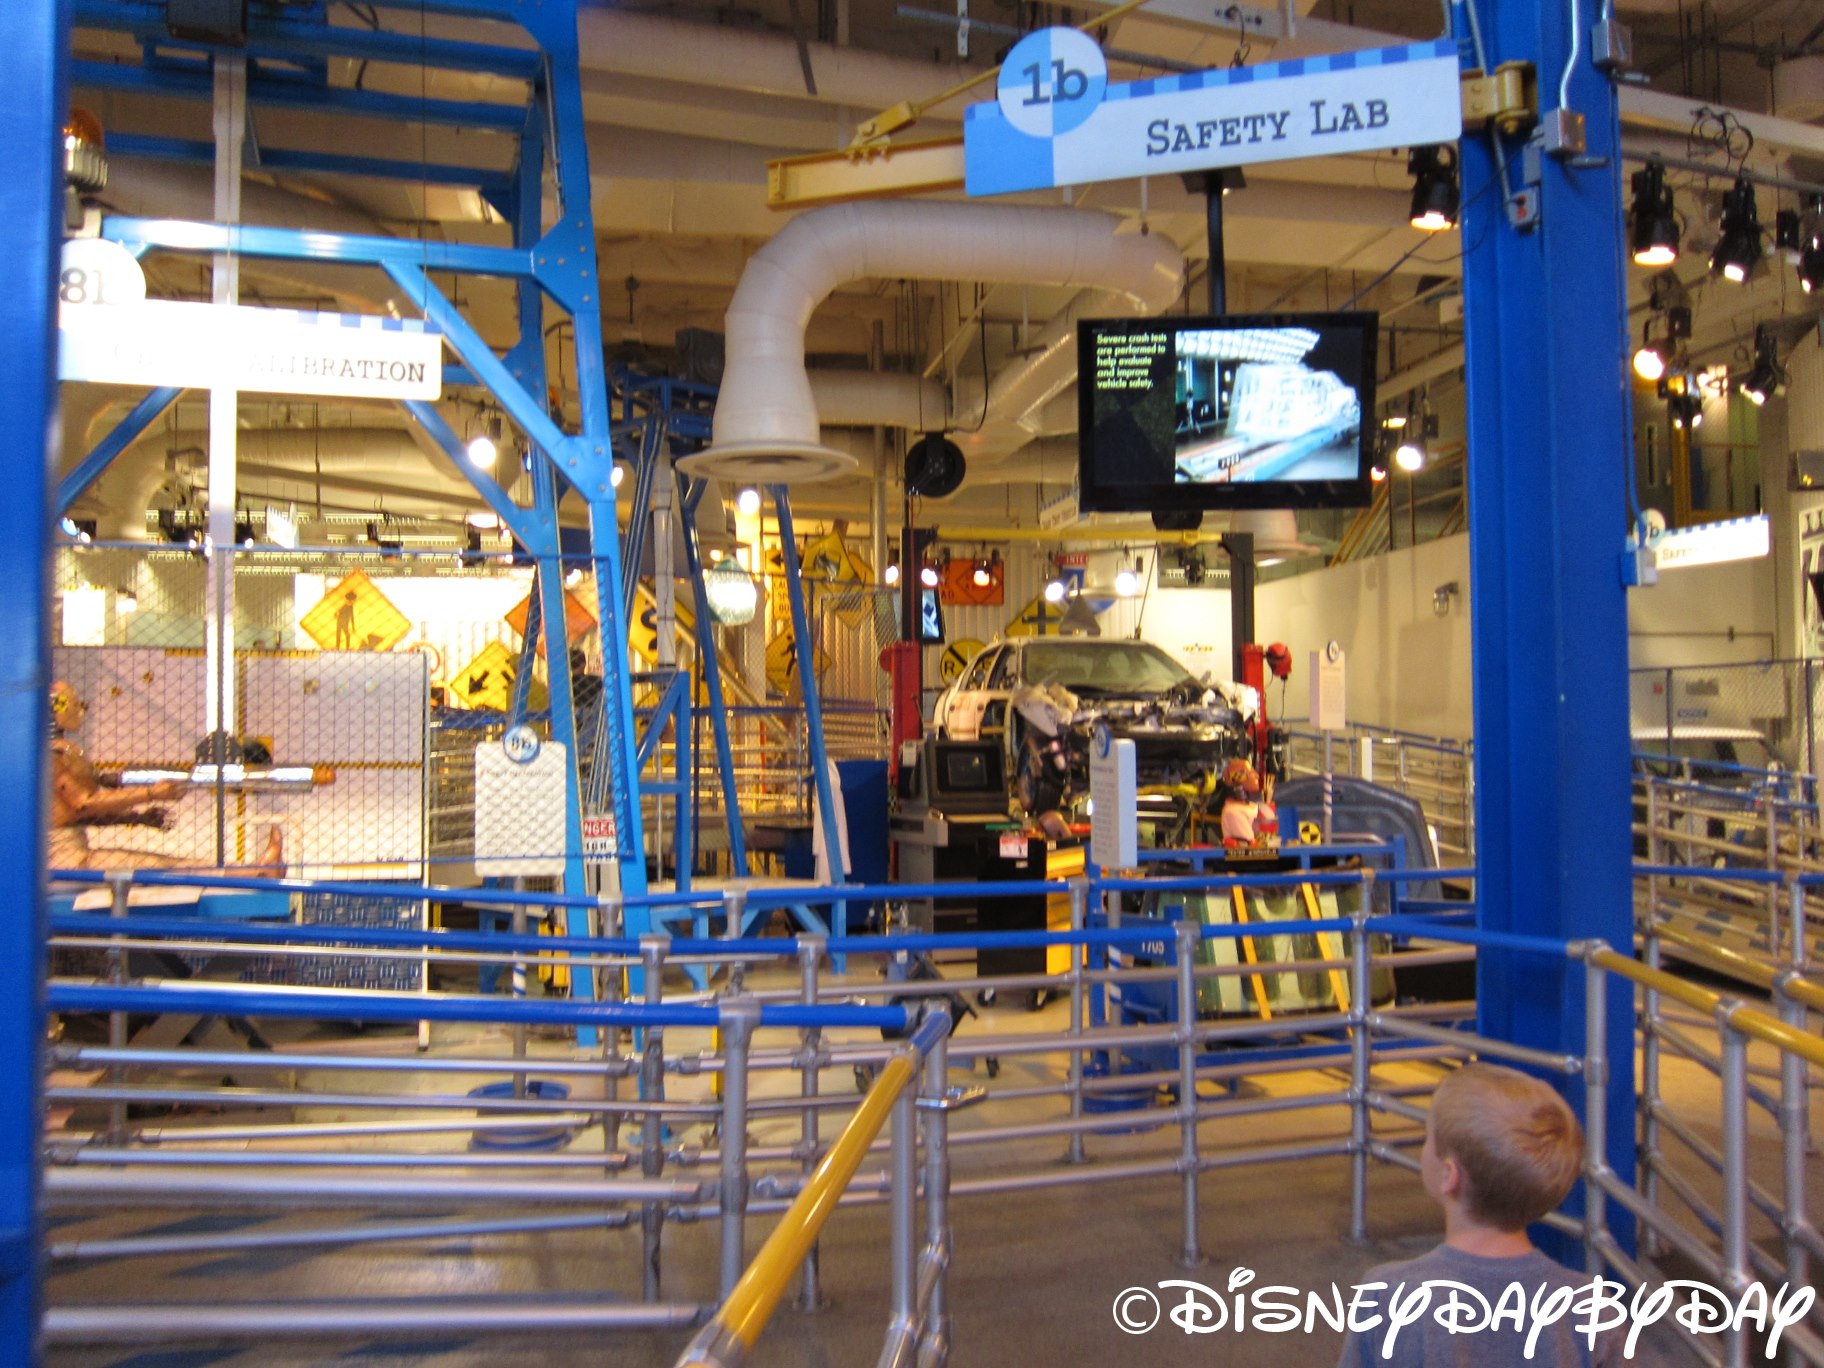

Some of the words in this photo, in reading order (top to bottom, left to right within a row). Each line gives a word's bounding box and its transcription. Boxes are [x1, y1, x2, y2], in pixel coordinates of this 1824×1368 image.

[1022, 57, 1089, 106] 1b
[1146, 110, 1290, 157] SAFETY
[1310, 99, 1390, 135] LAB
[1097, 333, 1127, 345] Severe
[1128, 332, 1150, 344] crash
[1151, 332, 1167, 343] tests
[1096, 346, 1113, 356] are
[1114, 343, 1157, 357] performed
[1158, 344, 1166, 354] to
[1097, 356, 1117, 368] help
[1118, 355, 1152, 366] evaluate
[1097, 367, 1115, 378] and
[1116, 367, 1149, 380] improve
[1097, 378, 1127, 389] vehicle
[1129, 377, 1154, 390] safety.
[583, 820, 616, 836] NGER
